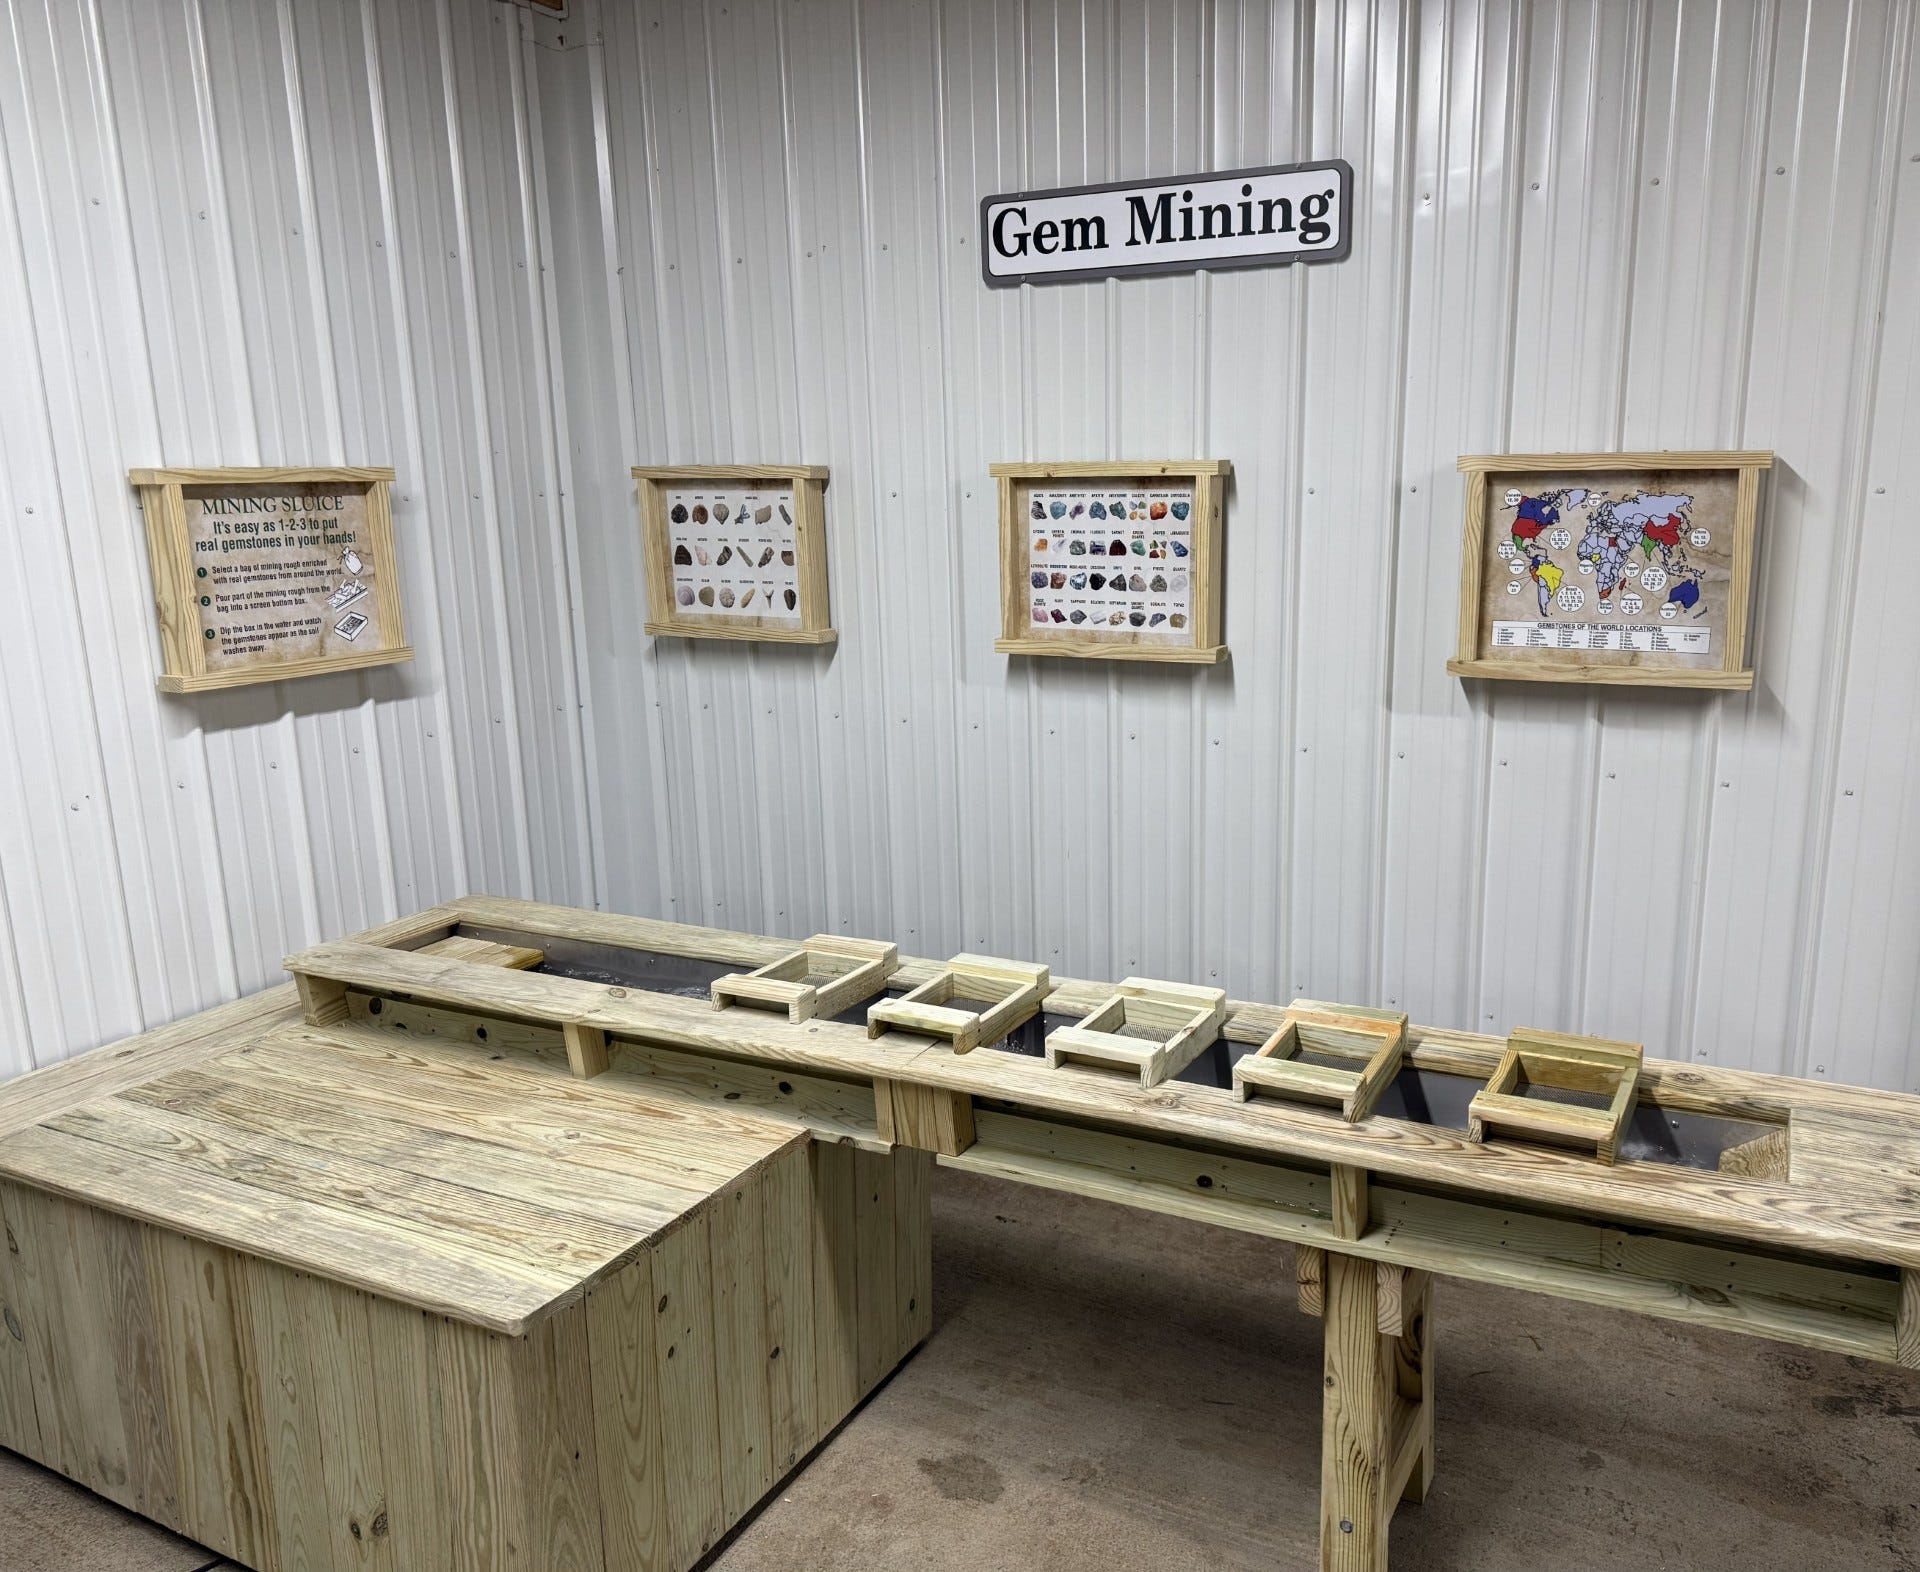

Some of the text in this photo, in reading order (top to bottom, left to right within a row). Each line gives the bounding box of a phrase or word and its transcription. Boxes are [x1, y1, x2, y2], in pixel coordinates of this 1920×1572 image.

[991, 183, 1335, 257] Gem Mining
[202, 496, 344, 514] MINING SLUICE
[213, 517, 338, 535] It's easy as 1-2-3 to put
[195, 531, 357, 553] real gemstones in your hands!
[212, 565, 233, 574] Select
[240, 564, 251, 572] bag
[260, 562, 282, 571] mining
[284, 561, 300, 569] rough
[302, 559, 327, 567] enriched
[229, 575, 241, 583] real
[243, 573, 277, 583] gemstones
[294, 570, 314, 578] around
[215, 594, 230, 602] Pour
[232, 593, 245, 602] part
[246, 591, 253, 599] of
[288, 587, 305, 595] rough
[216, 605, 229, 613] bag
[272, 599, 293, 607] bottom
[221, 626, 231, 635] Dip
[264, 622, 273, 630] the
[275, 620, 291, 628] water
[293, 619, 303, 627] and
[305, 617, 322, 625] watch
[233, 635, 267, 645] gemstones
[268, 632, 288, 640] appear
[223, 646, 247, 655] washes
